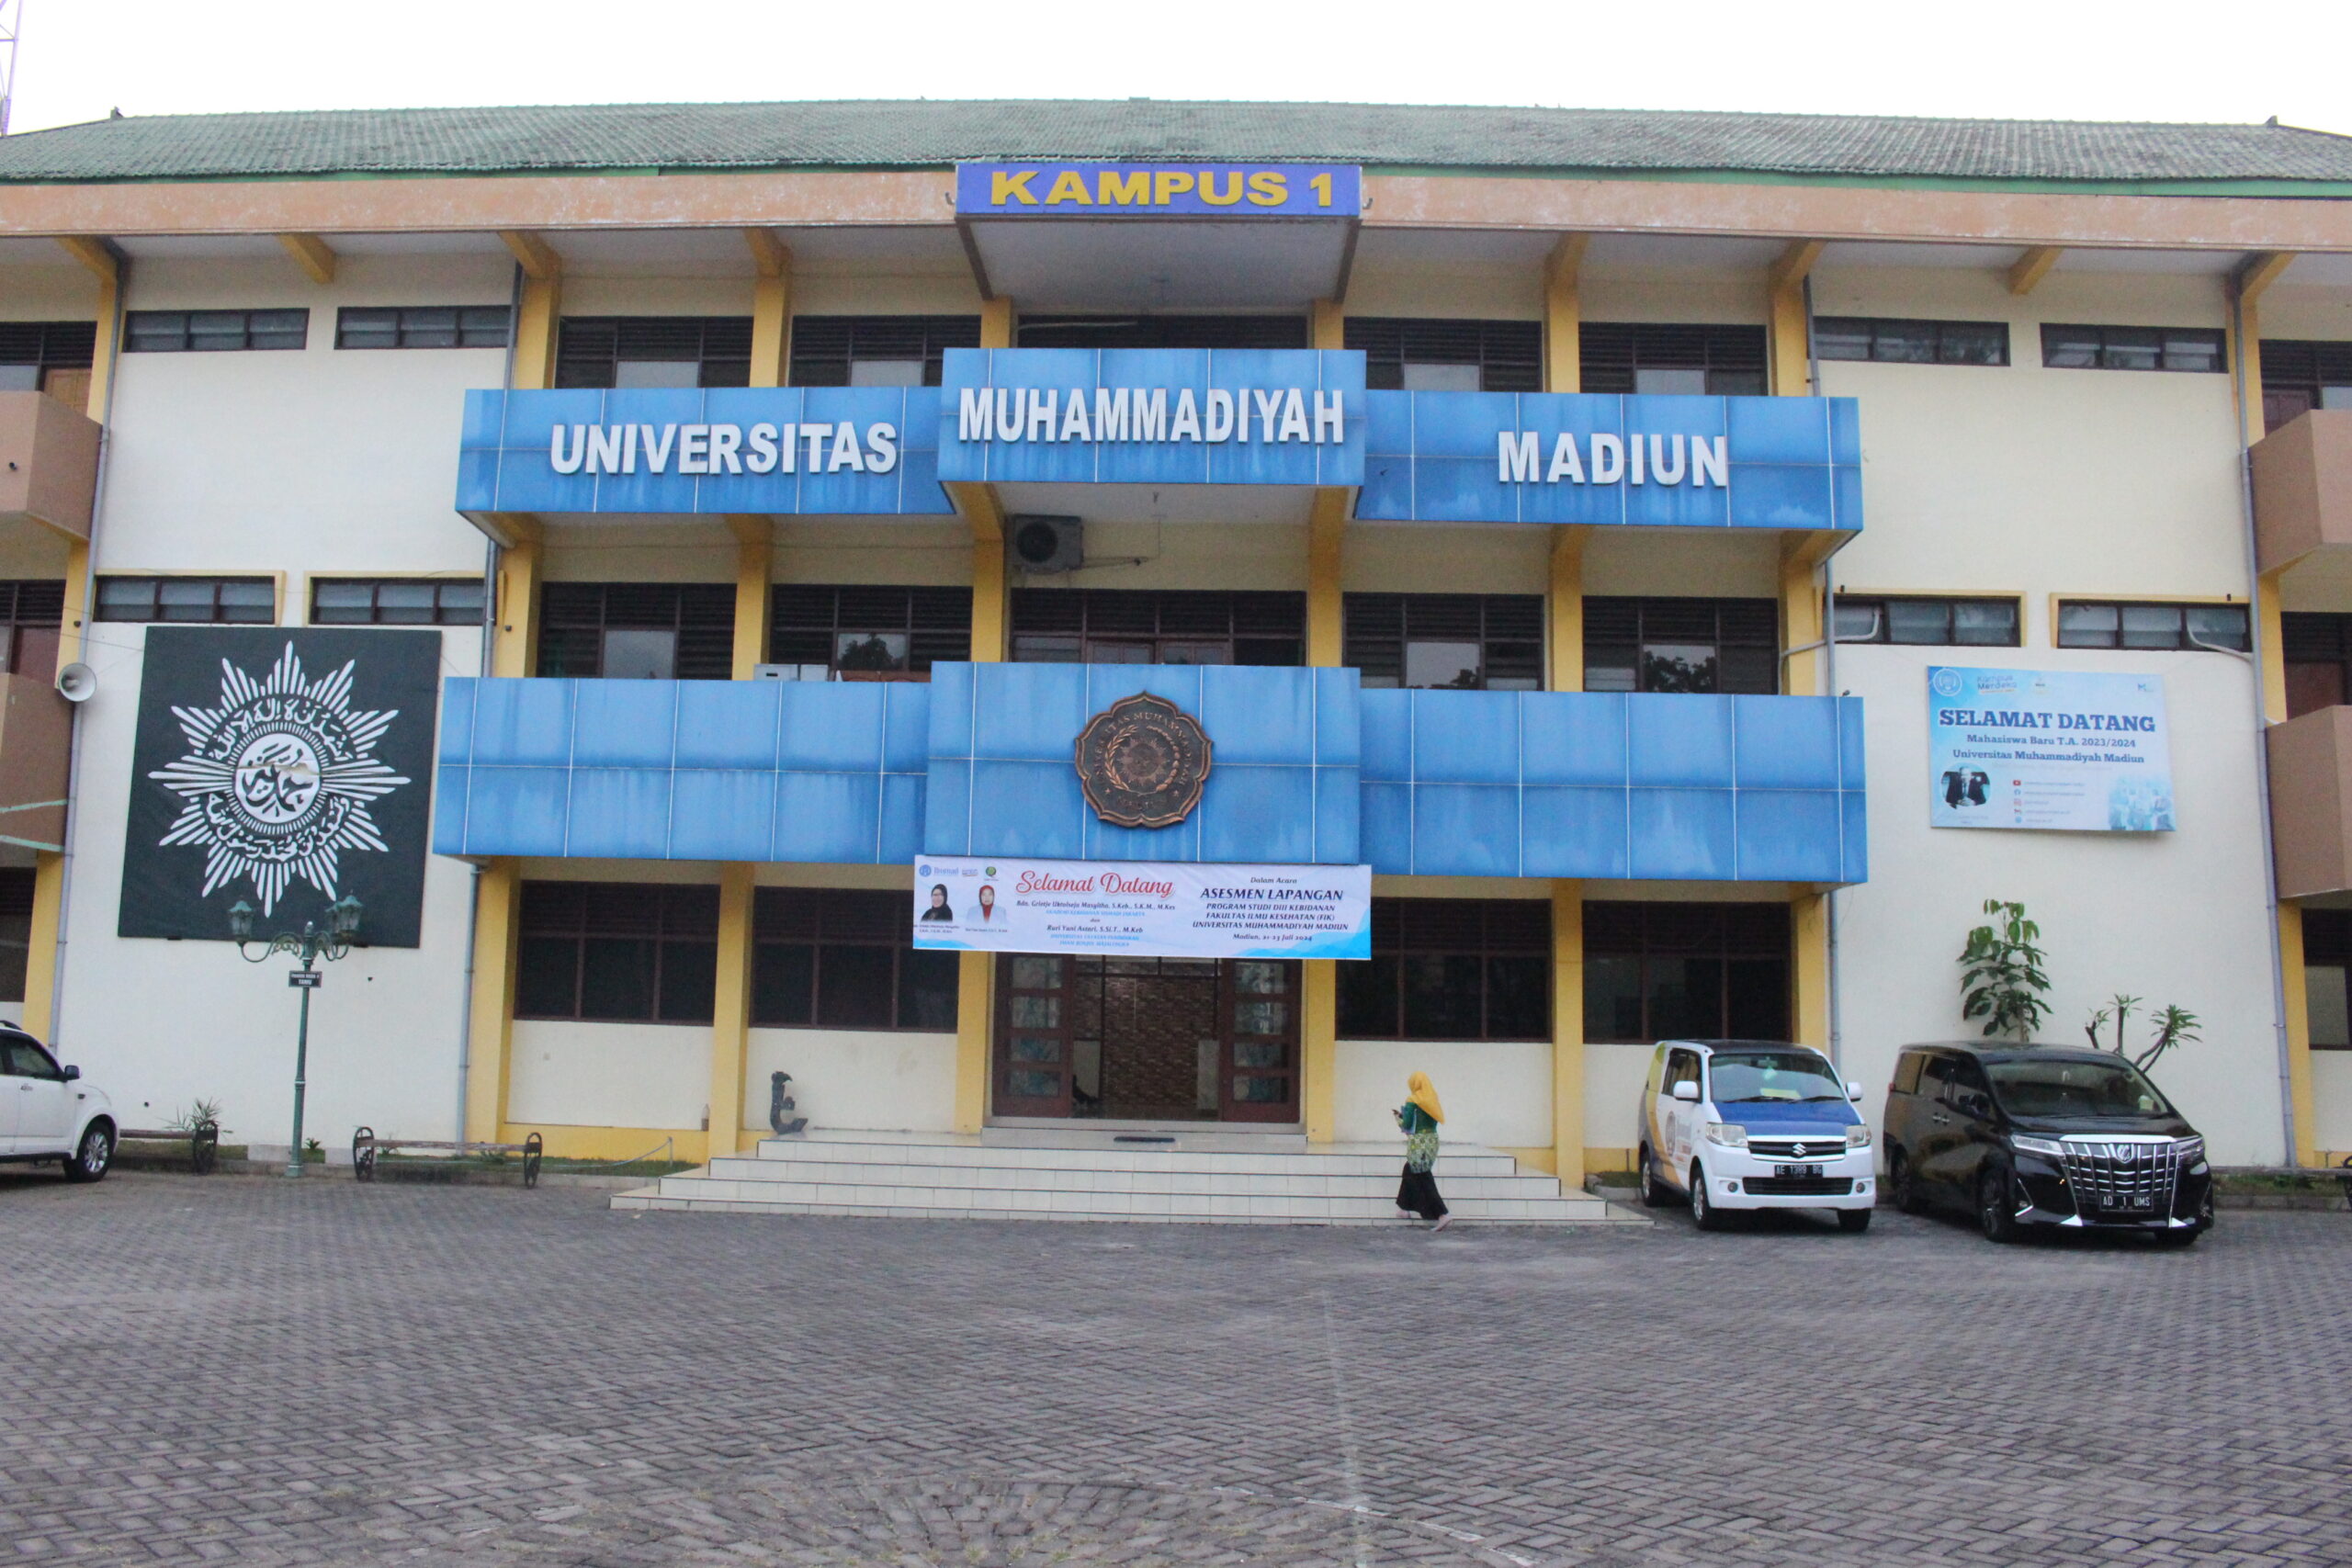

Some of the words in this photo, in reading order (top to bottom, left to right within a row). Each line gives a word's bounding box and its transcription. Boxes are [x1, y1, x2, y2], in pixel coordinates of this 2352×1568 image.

[991, 171, 1289, 206] KAMPUS
[1309, 173, 1332, 207] 1
[551, 422, 897, 474] UNIVERSITAS
[959, 388, 1343, 444] MUHAMMADIYAH
[1498, 431, 1727, 487] MADIUN
[1939, 709, 2052, 728] SELAMAT
[2058, 713, 2155, 732] DATANG
[1967, 734, 2027, 744] Mahasiswa
[2030, 736, 2054, 745] Baru
[2057, 738, 2079, 746] T.A.
[2081, 738, 2136, 748] 2023/2024
[1953, 750, 2012, 760] Universitas
[2015, 750, 2102, 763] Muhammadiyah
[2104, 753, 2145, 763] Madiun
[1015, 870, 1094, 894] Selamat
[1100, 872, 1174, 898] Datang
[1200, 887, 1264, 899] ASESMEN
[1268, 889, 1343, 900] LAPANGAN
[1193, 920, 1243, 929] UNIVERSITAS
[1245, 921, 1314, 930] MUHAMMADIYAH
[2103, 1195, 2113, 1206] AD
[2133, 1196, 2150, 1206] UMS
